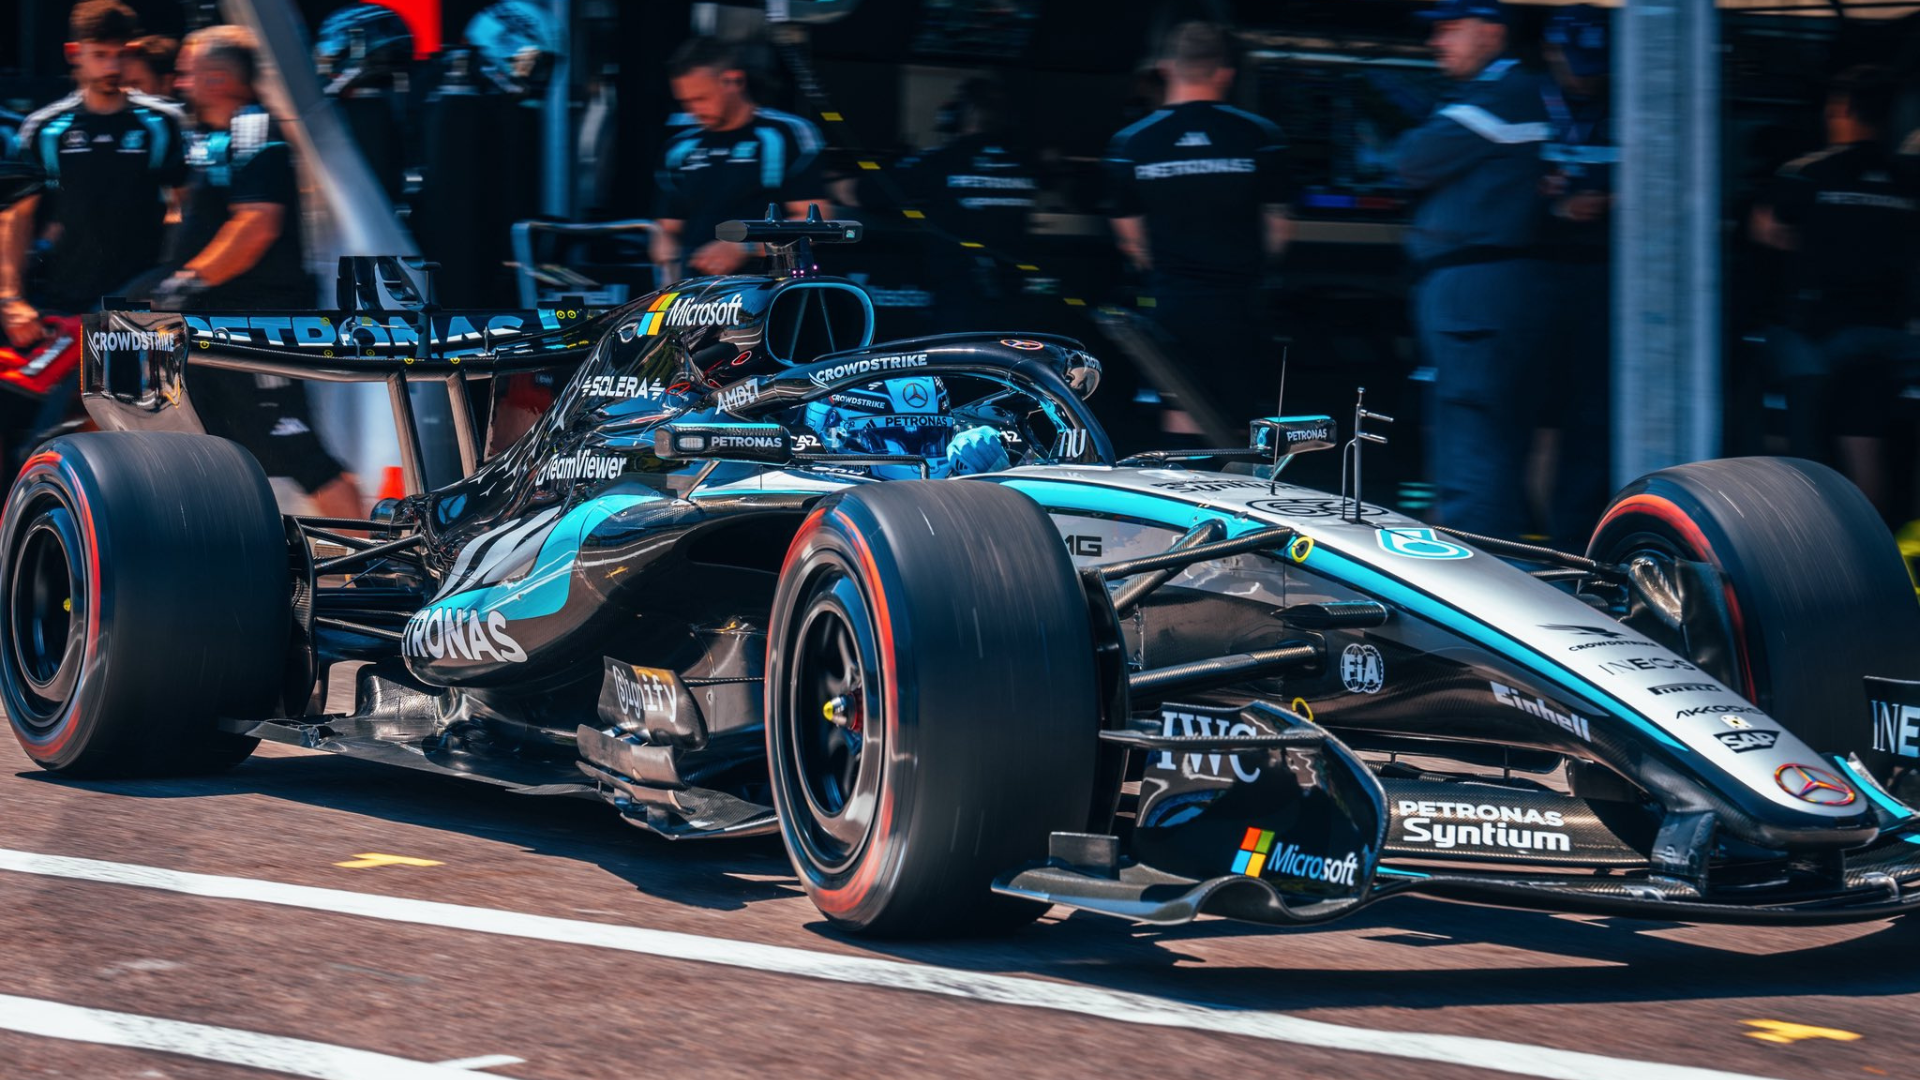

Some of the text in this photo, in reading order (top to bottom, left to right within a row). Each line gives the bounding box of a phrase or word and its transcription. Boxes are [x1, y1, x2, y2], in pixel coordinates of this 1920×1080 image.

[665, 294, 743, 327] Microsoft
[93, 331, 175, 352] CROWDSTRIKE
[815, 354, 928, 383] CROWDSTRIKE
[590, 376, 648, 399] SOLERA
[831, 394, 886, 410] CROWDSTRIKE
[885, 416, 948, 427] PETRONAS
[710, 436, 782, 449] PETRONAS
[1286, 428, 1328, 442] PETRONAS
[546, 449, 628, 481] TeamViewer
[401, 607, 528, 664] TRONAS
[1568, 640, 1660, 652] CROWDSTRIKE
[1598, 657, 1699, 676] INEOS
[1489, 680, 1592, 743] Einhell
[1156, 711, 1261, 783] IWC
[1720, 731, 1776, 751] SAP
[1397, 800, 1565, 827] PETRONAS
[1402, 817, 1571, 852] Syntium
[1267, 842, 1358, 886] Microsoft
